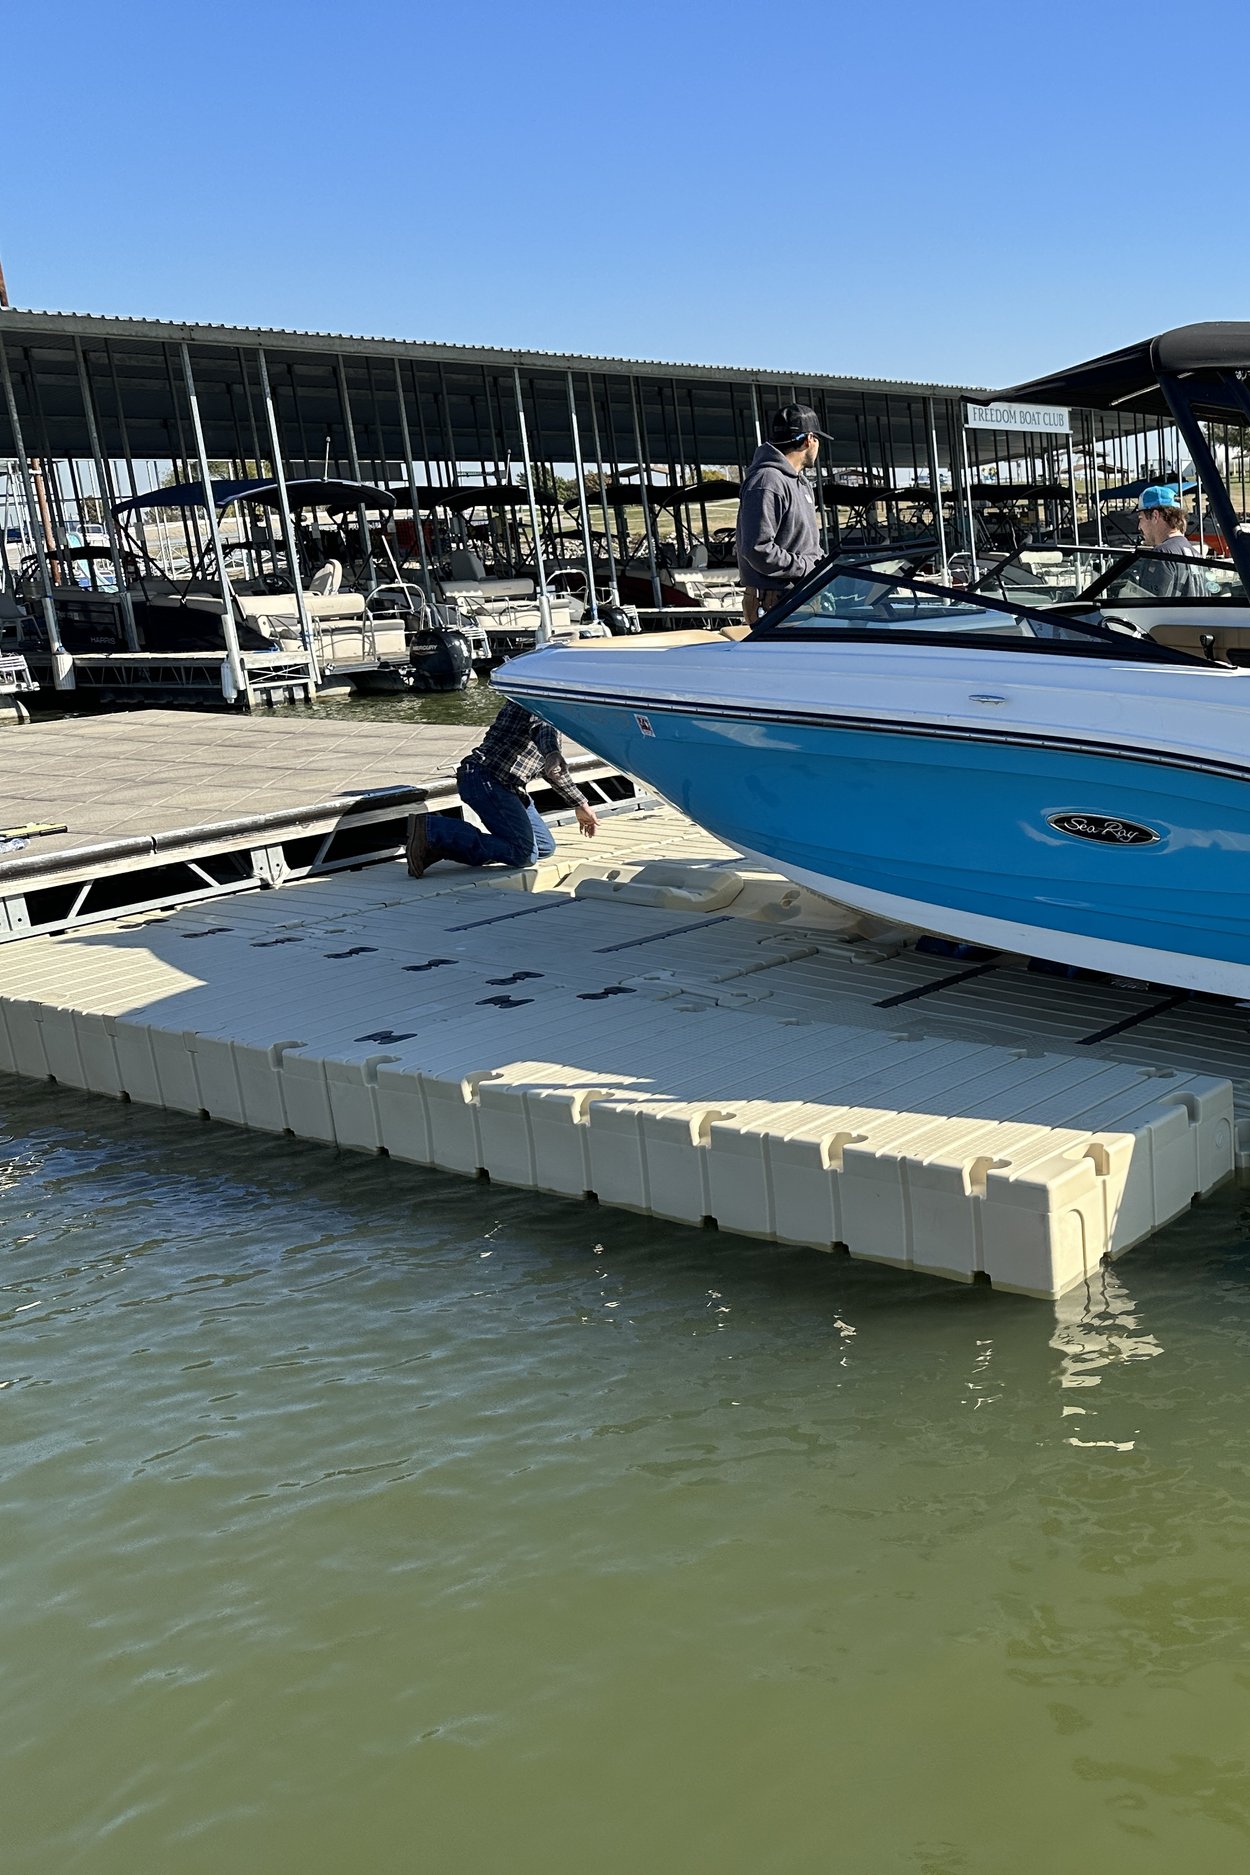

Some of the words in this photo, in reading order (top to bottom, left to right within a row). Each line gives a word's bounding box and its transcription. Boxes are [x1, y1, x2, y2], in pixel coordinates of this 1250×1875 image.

[973, 407, 1017, 424] FREEDOM
[1020, 410, 1041, 426] BOAT
[1043, 412, 1065, 427] CLUB
[1064, 818, 1099, 834] Sea
[1101, 821, 1139, 842] Ray
